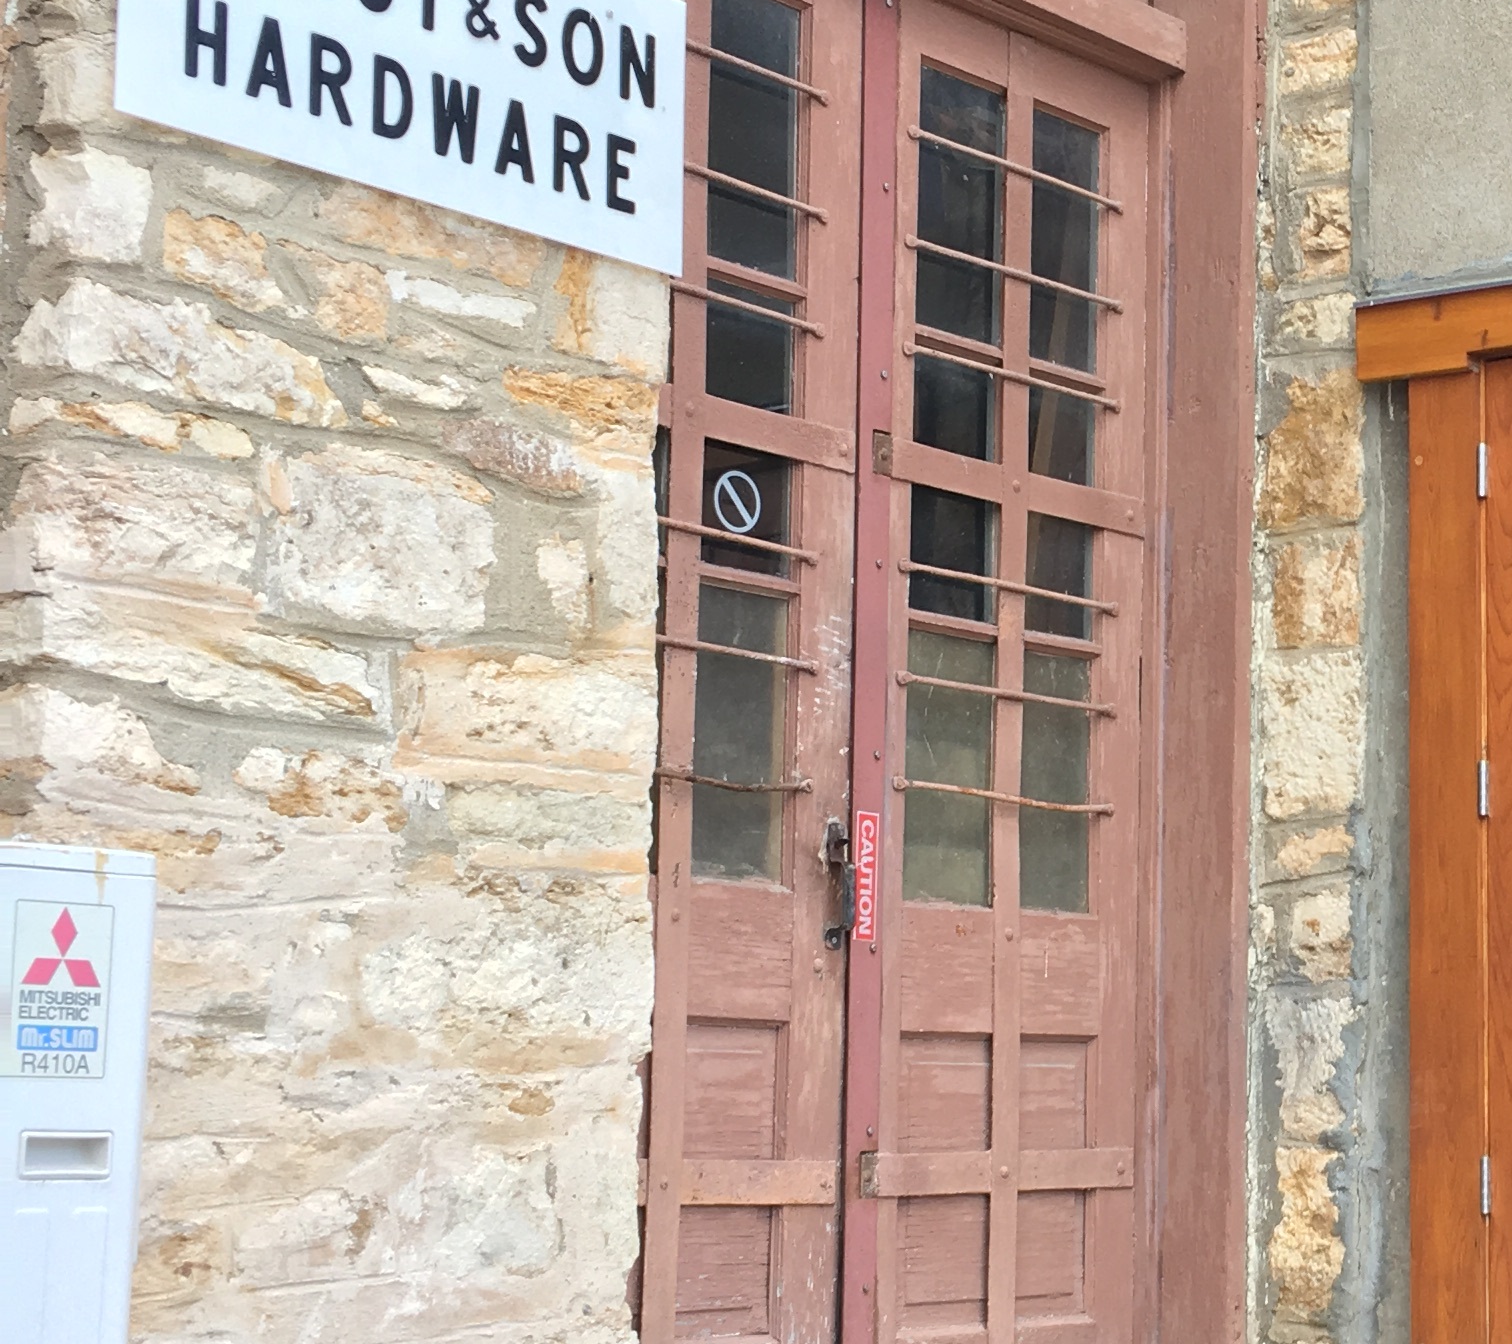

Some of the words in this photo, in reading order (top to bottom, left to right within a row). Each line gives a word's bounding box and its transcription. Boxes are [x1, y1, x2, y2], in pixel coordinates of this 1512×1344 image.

[859, 820, 874, 934] CAUTION
[20, 990, 101, 1006] MITSUBISHI
[19, 1005, 89, 1021] ELECTRIC
[21, 1053, 90, 1074] R410A
